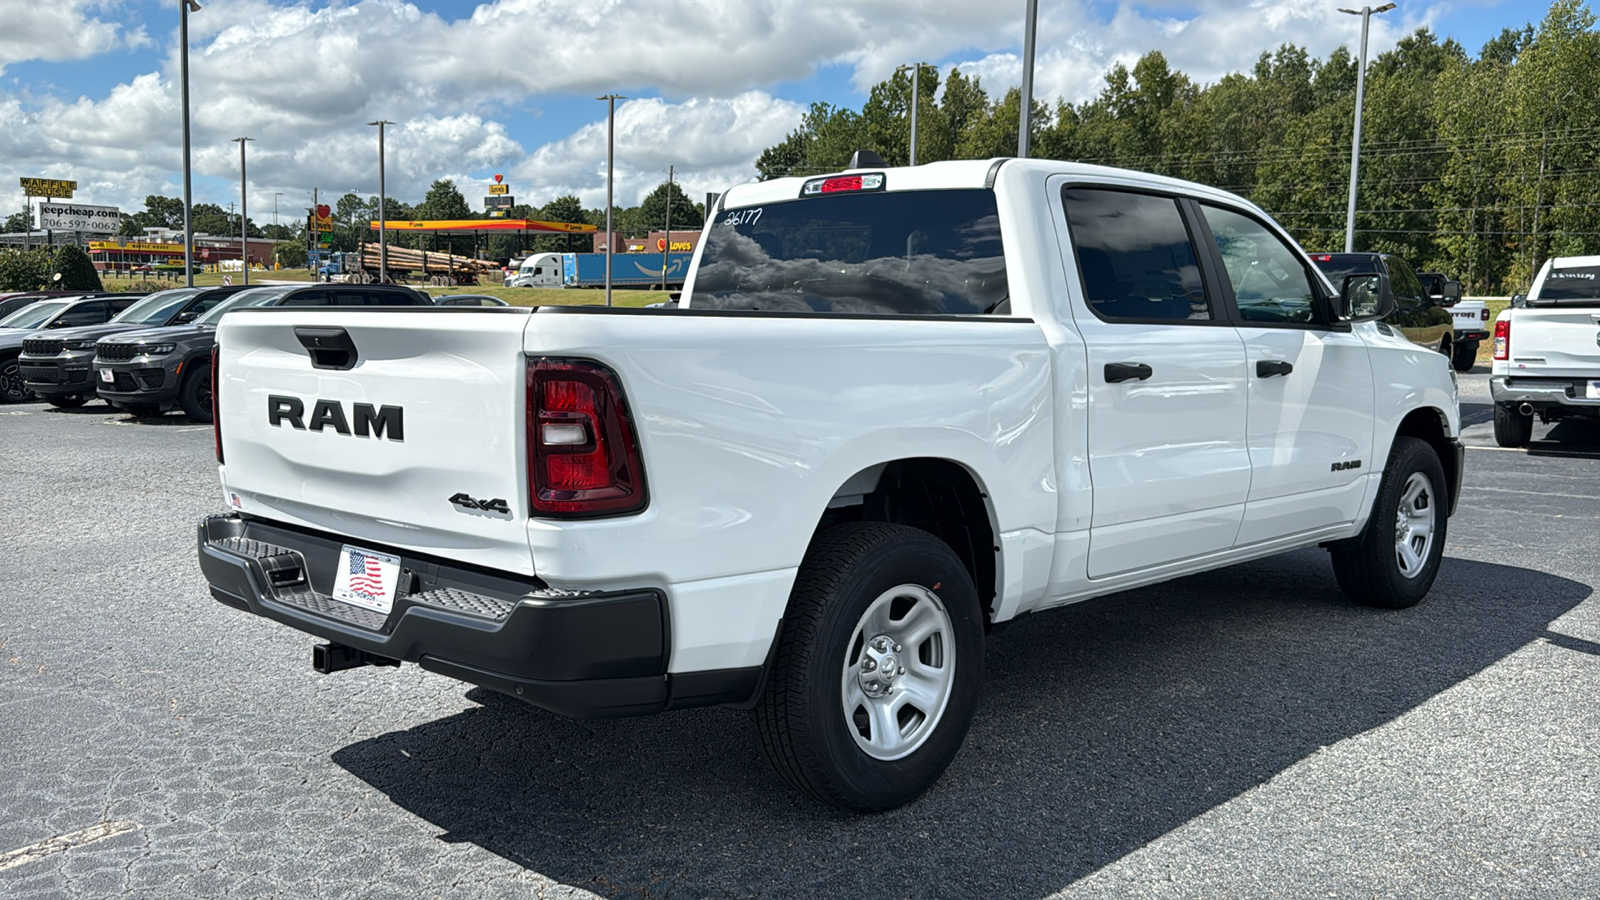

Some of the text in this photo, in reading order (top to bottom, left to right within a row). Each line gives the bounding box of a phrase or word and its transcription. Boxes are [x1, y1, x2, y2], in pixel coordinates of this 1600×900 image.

[21, 177, 76, 189] WAFFLE
[28, 188, 72, 198] HOUSE
[40, 204, 118, 219] jeepcheap.com
[724, 207, 763, 226] 26177
[43, 218, 117, 231] 706-597-0062
[268, 394, 405, 443] RAM
[1330, 459, 1362, 472] RAM
